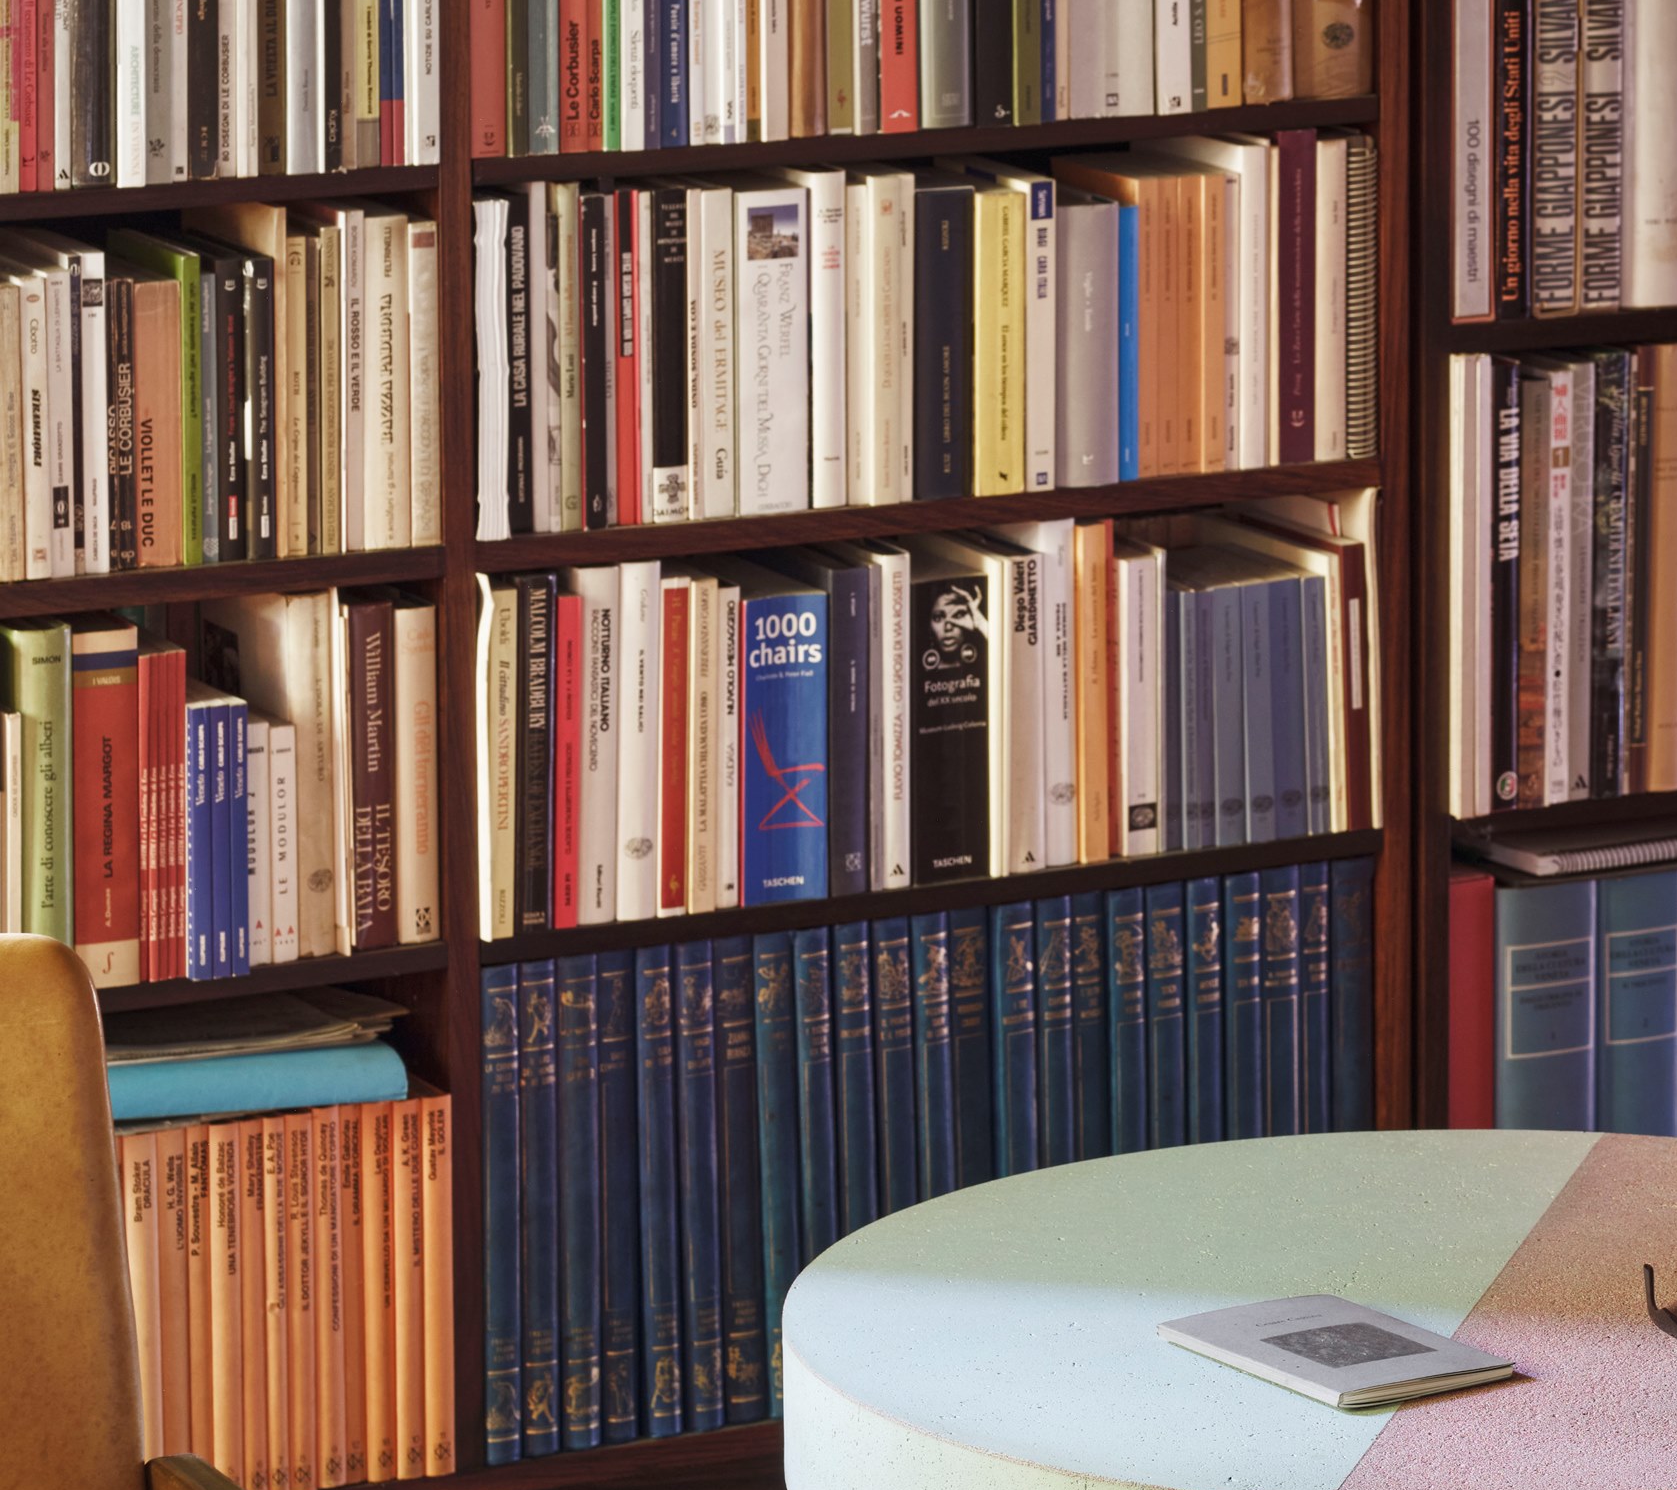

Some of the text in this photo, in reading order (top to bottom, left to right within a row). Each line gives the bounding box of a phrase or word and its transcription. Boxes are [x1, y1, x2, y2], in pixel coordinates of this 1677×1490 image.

[566, 20, 579, 119] Le Corbusier
[589, 37, 600, 119] Carlo Scarpa
[1502, 11, 1519, 302] Un giorno nella vita degli Stati Uniti
[1535, 89, 1575, 218] GIAPPONESI
[511, 225, 526, 405] LA CASA RURALE NEL PADOVANO
[1534, 225, 1574, 301] FORME
[118, 363, 132, 476] LE CORBUSIER
[140, 418, 154, 547] VIOLLET LE DUC
[749, 640, 822, 669] chairs
[754, 612, 817, 640] 1000
[365, 631, 380, 771] William Martin
[41, 721, 54, 909] l'arte di conoscere gli alberi
[102, 737, 113, 878] LA REGINA MARGOT
[277, 775, 287, 894] LE MODULOR
[762, 875, 805, 889] TASCHEN
[132, 1161, 145, 1223] Bram Stoker
[142, 1159, 151, 1209] DRACULA
